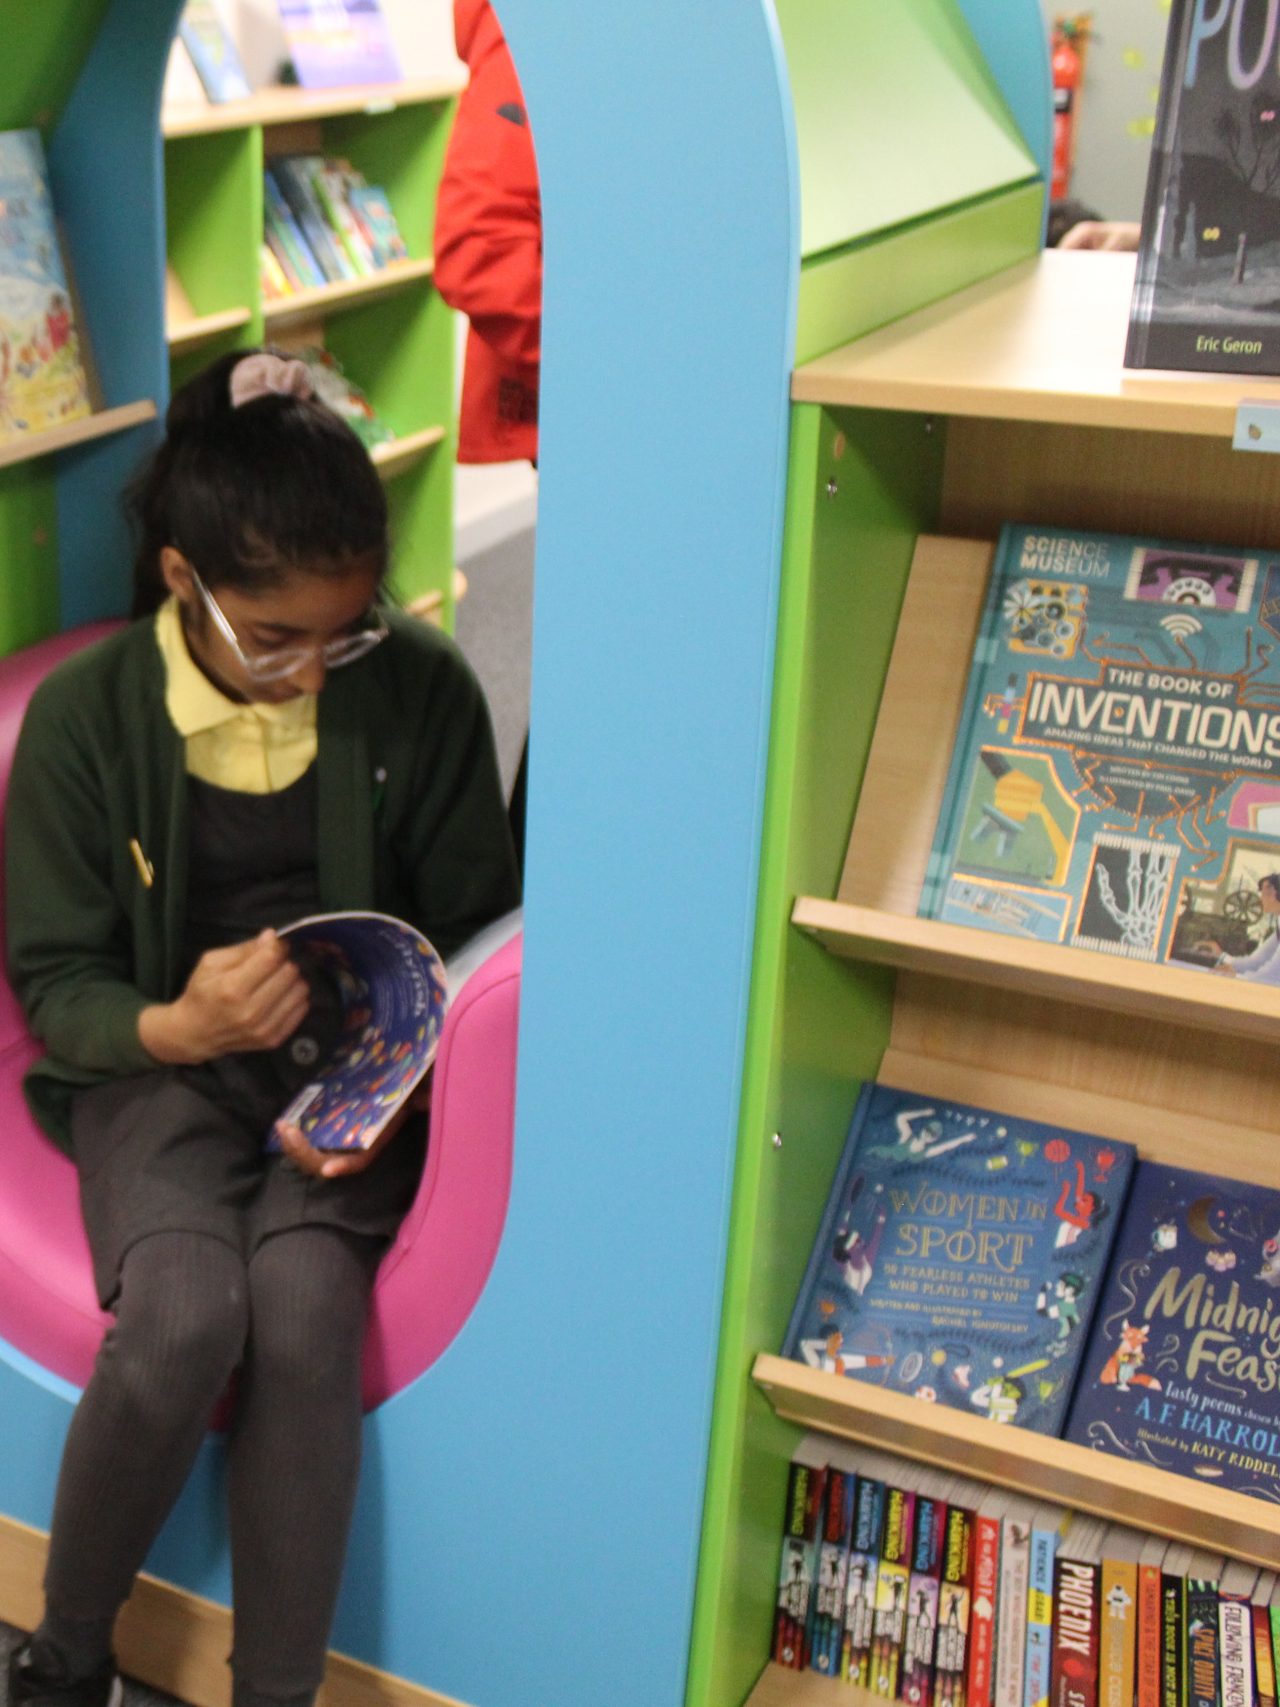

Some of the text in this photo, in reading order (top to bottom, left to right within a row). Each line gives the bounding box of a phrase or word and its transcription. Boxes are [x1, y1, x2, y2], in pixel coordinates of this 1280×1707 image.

[1183, 0, 1280, 90] PO
[1195, 335, 1263, 354] Eric Geron
[1020, 553, 1110, 578] MUSEUM
[1024, 535, 1109, 560] SCIENCE
[1108, 668, 1235, 699] THE BOOK OF
[1044, 726, 1273, 769] AMAZING IDEAS THAT CHANGED THE WORLD
[890, 1181, 1019, 1229] WOMEN
[895, 1223, 1034, 1274] SPORT
[889, 1279, 1019, 1303] WHO PLAYED TO WIN
[903, 1264, 964, 1282] FEARLESS
[968, 1271, 1030, 1290] ATHLETES
[1186, 1329, 1280, 1392] Feas
[1201, 1395, 1243, 1417] poems
[1191, 1441, 1225, 1461] KATY
[1228, 1452, 1280, 1479] RIDDEL
[791, 1467, 808, 1536] HAWKING
[856, 1481, 874, 1550] HAWKING
[886, 1490, 904, 1560] HAWKING
[915, 1501, 933, 1571] HAWKING
[946, 1510, 964, 1582] HAWKING
[1035, 1539, 1048, 1584] PATIENCE
[1058, 1562, 1094, 1656] PHOENIX
[1165, 1625, 1176, 1650] BOOK
[1193, 1628, 1216, 1659] SPACE
[1224, 1605, 1243, 1662] FOLLOWING
[1165, 1652, 1176, 1664] IS
[1166, 1666, 1177, 1690] NOT
[1194, 1660, 1216, 1700] ODDITY
